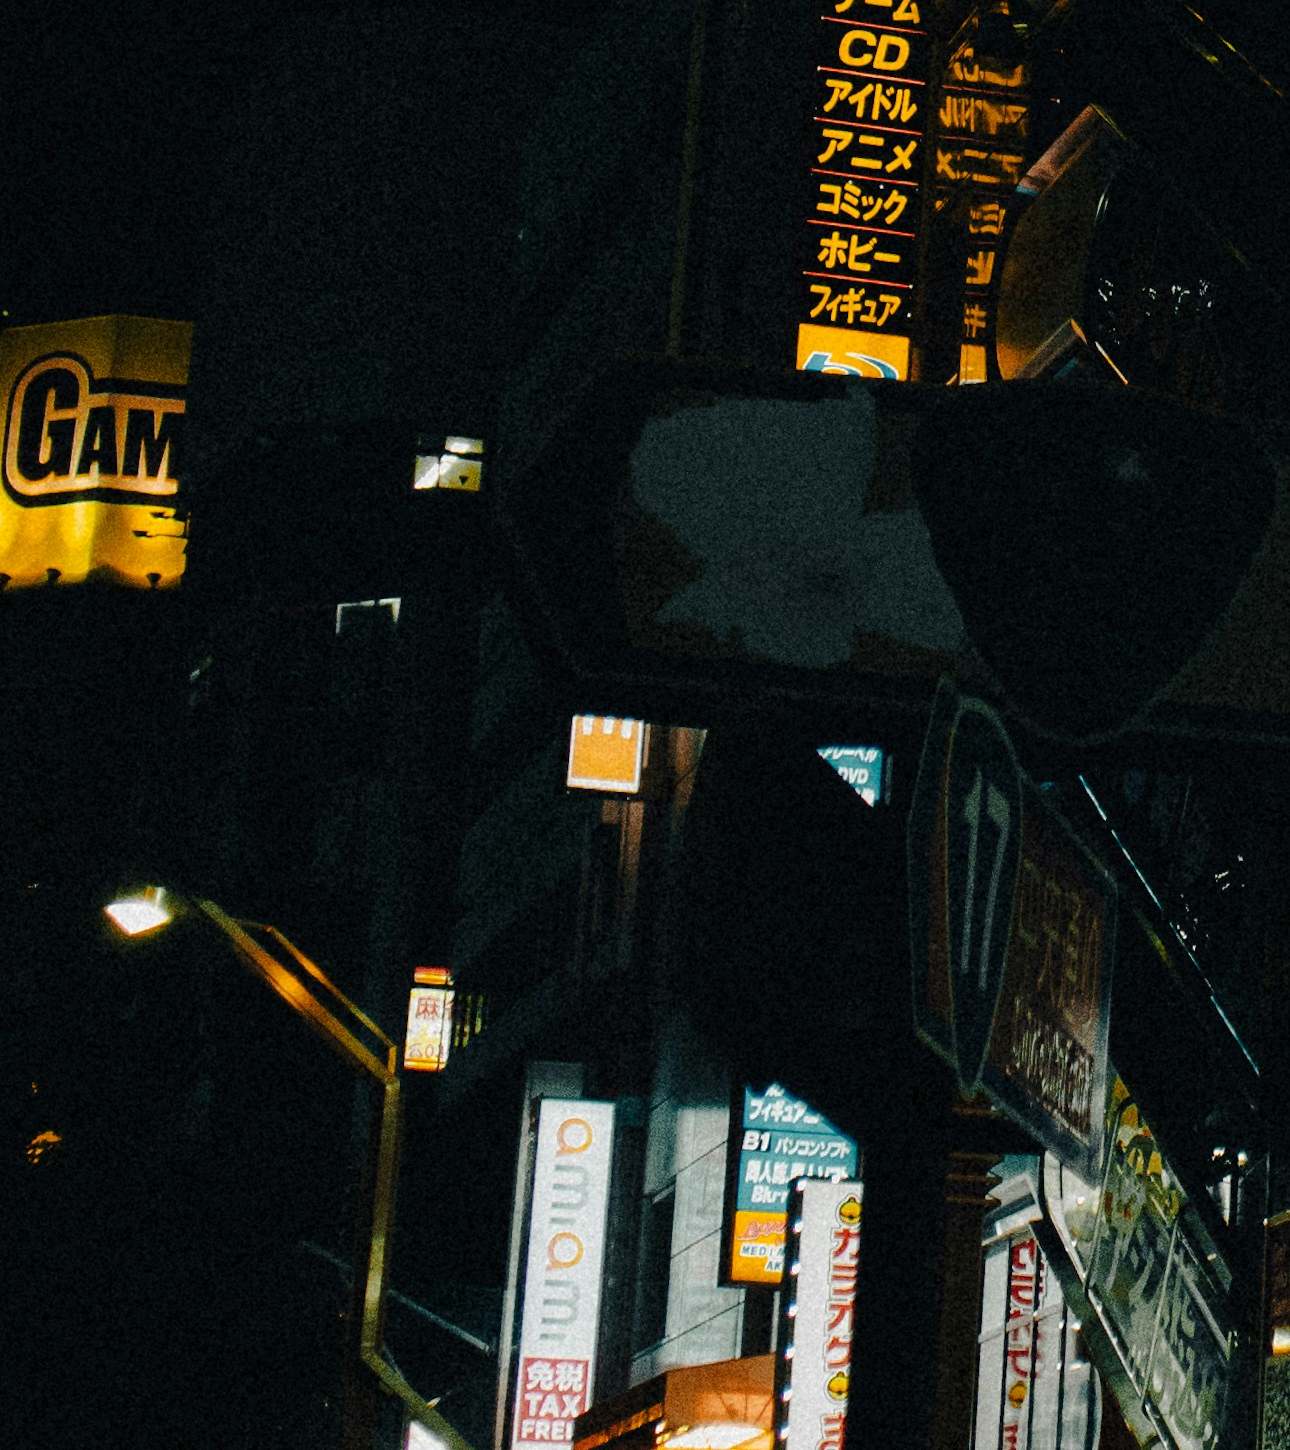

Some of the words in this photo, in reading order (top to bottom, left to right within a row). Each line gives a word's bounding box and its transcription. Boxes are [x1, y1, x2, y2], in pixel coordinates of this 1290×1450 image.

[838, 29, 910, 71] CD
[823, 77, 918, 123] アイドル
[817, 129, 918, 173] アニメ
[816, 181, 907, 225] コミック
[817, 230, 901, 272] ホビー
[809, 282, 902, 327] フィギュア
[742, 1130, 771, 1152] B1
[526, 1360, 585, 1391] 免税
[523, 1393, 580, 1419] TAX
